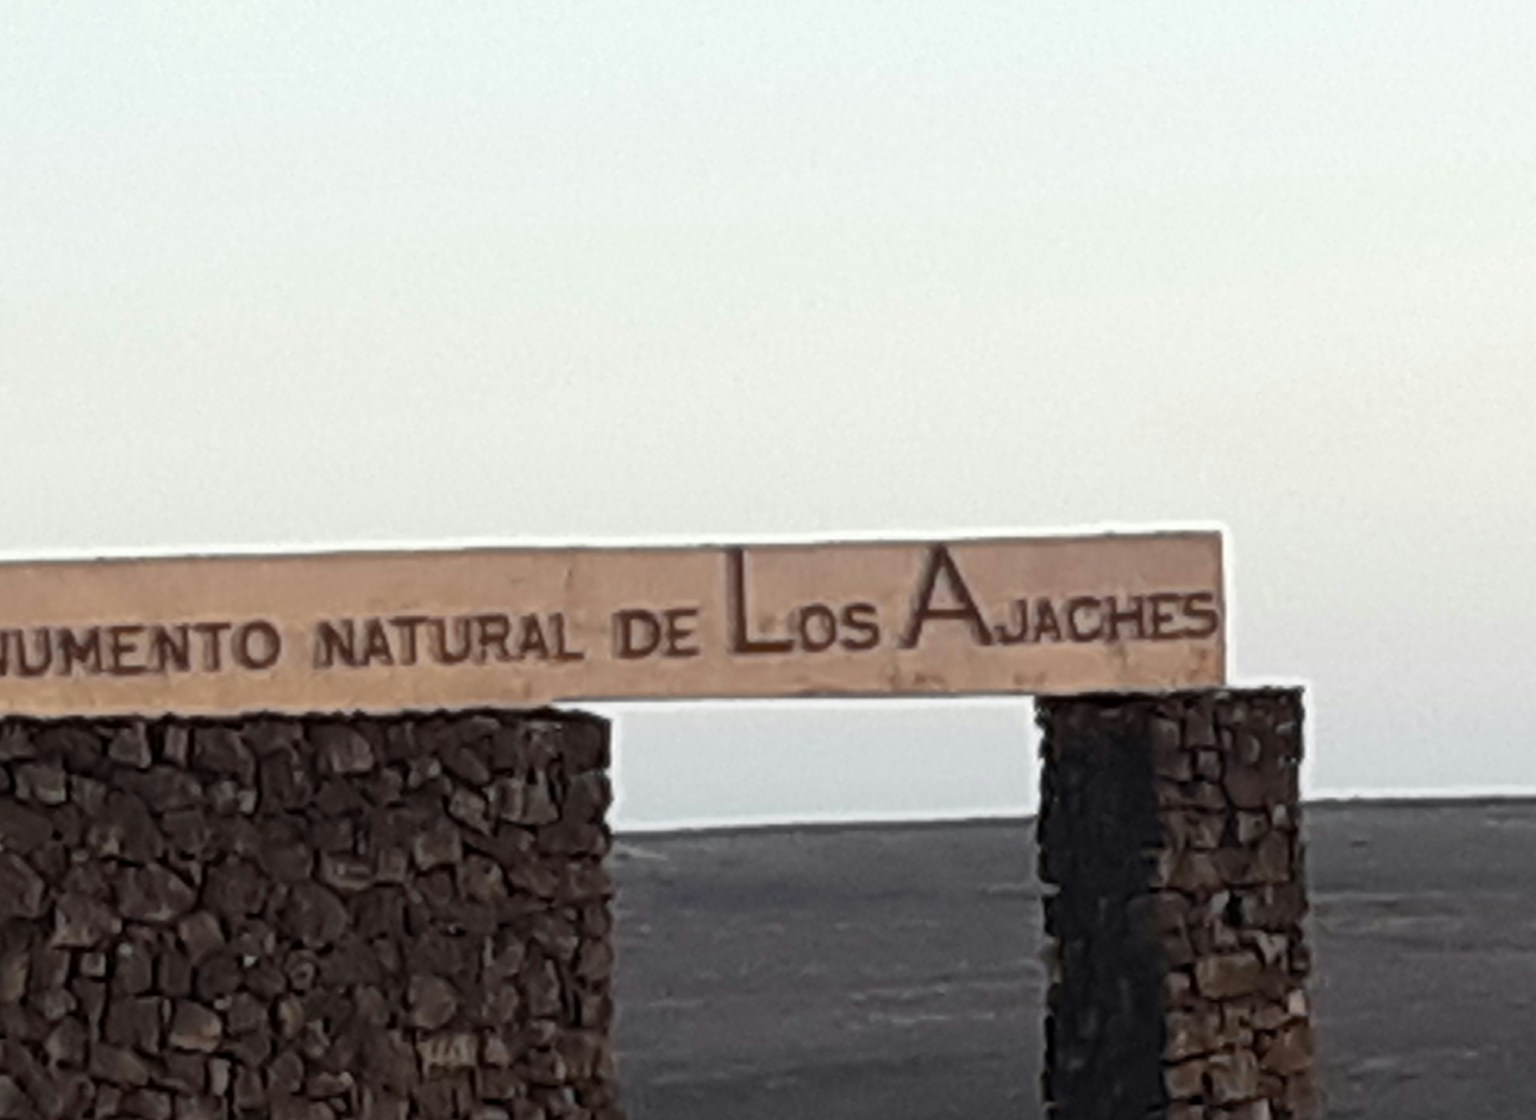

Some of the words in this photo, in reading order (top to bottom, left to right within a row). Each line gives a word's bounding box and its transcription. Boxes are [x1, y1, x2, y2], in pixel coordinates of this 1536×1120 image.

[318, 611, 584, 668] NATURAL
[616, 608, 700, 659] DE
[726, 547, 881, 654] LOS
[900, 542, 1218, 649] AJACHES
